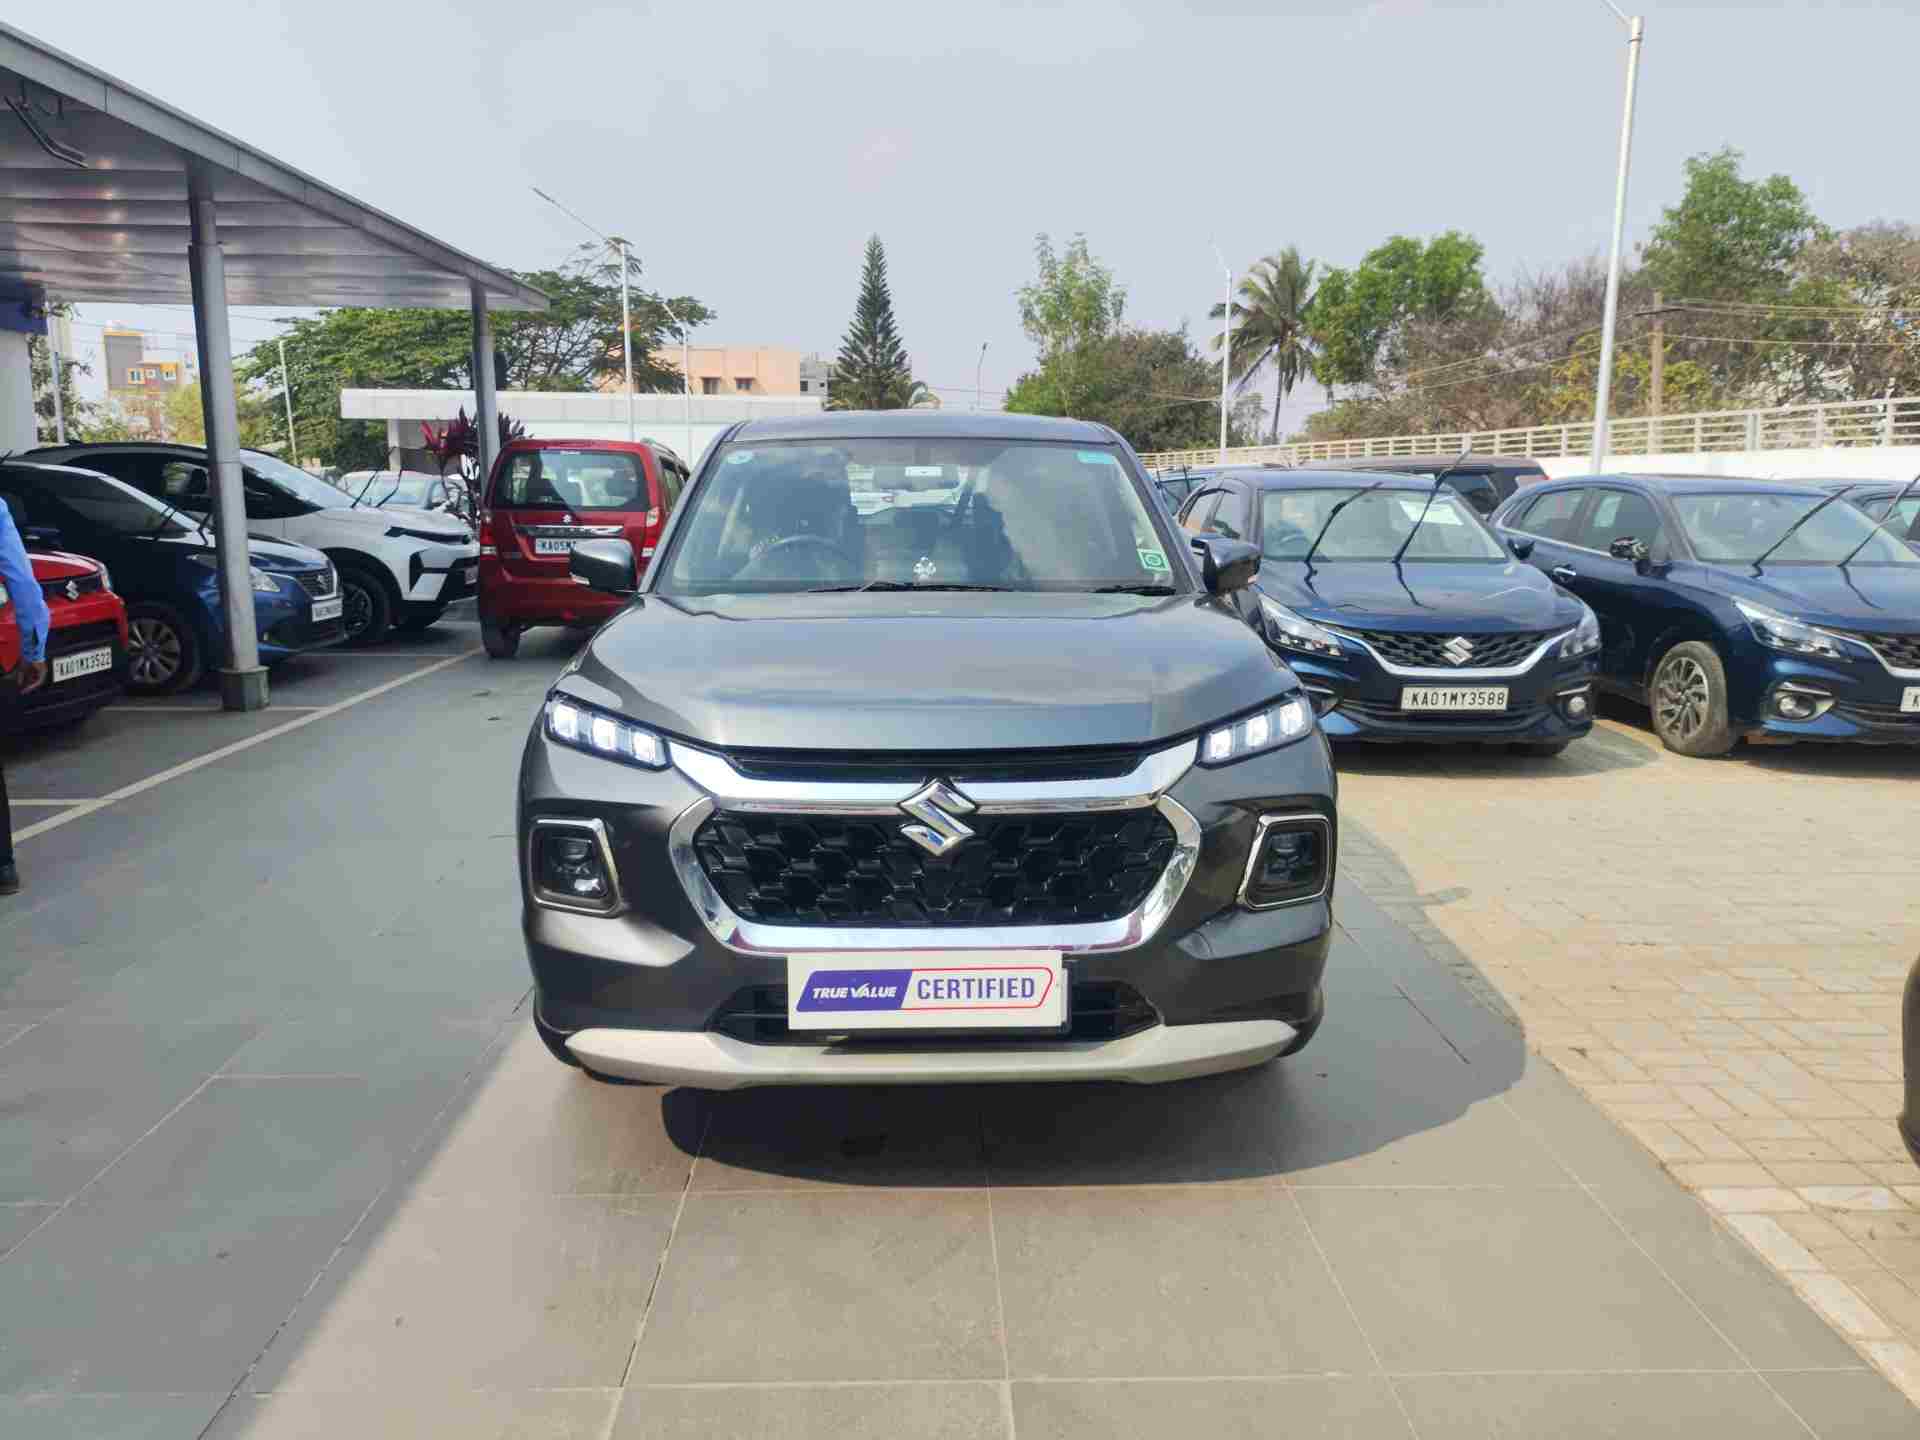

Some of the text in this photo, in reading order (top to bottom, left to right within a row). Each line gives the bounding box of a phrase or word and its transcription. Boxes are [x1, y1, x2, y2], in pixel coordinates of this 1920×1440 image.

[1412, 691, 1505, 706] KA01MY3588
[811, 983, 897, 999] TRUE VALUE
[917, 977, 1035, 1000] CERTIFIED
